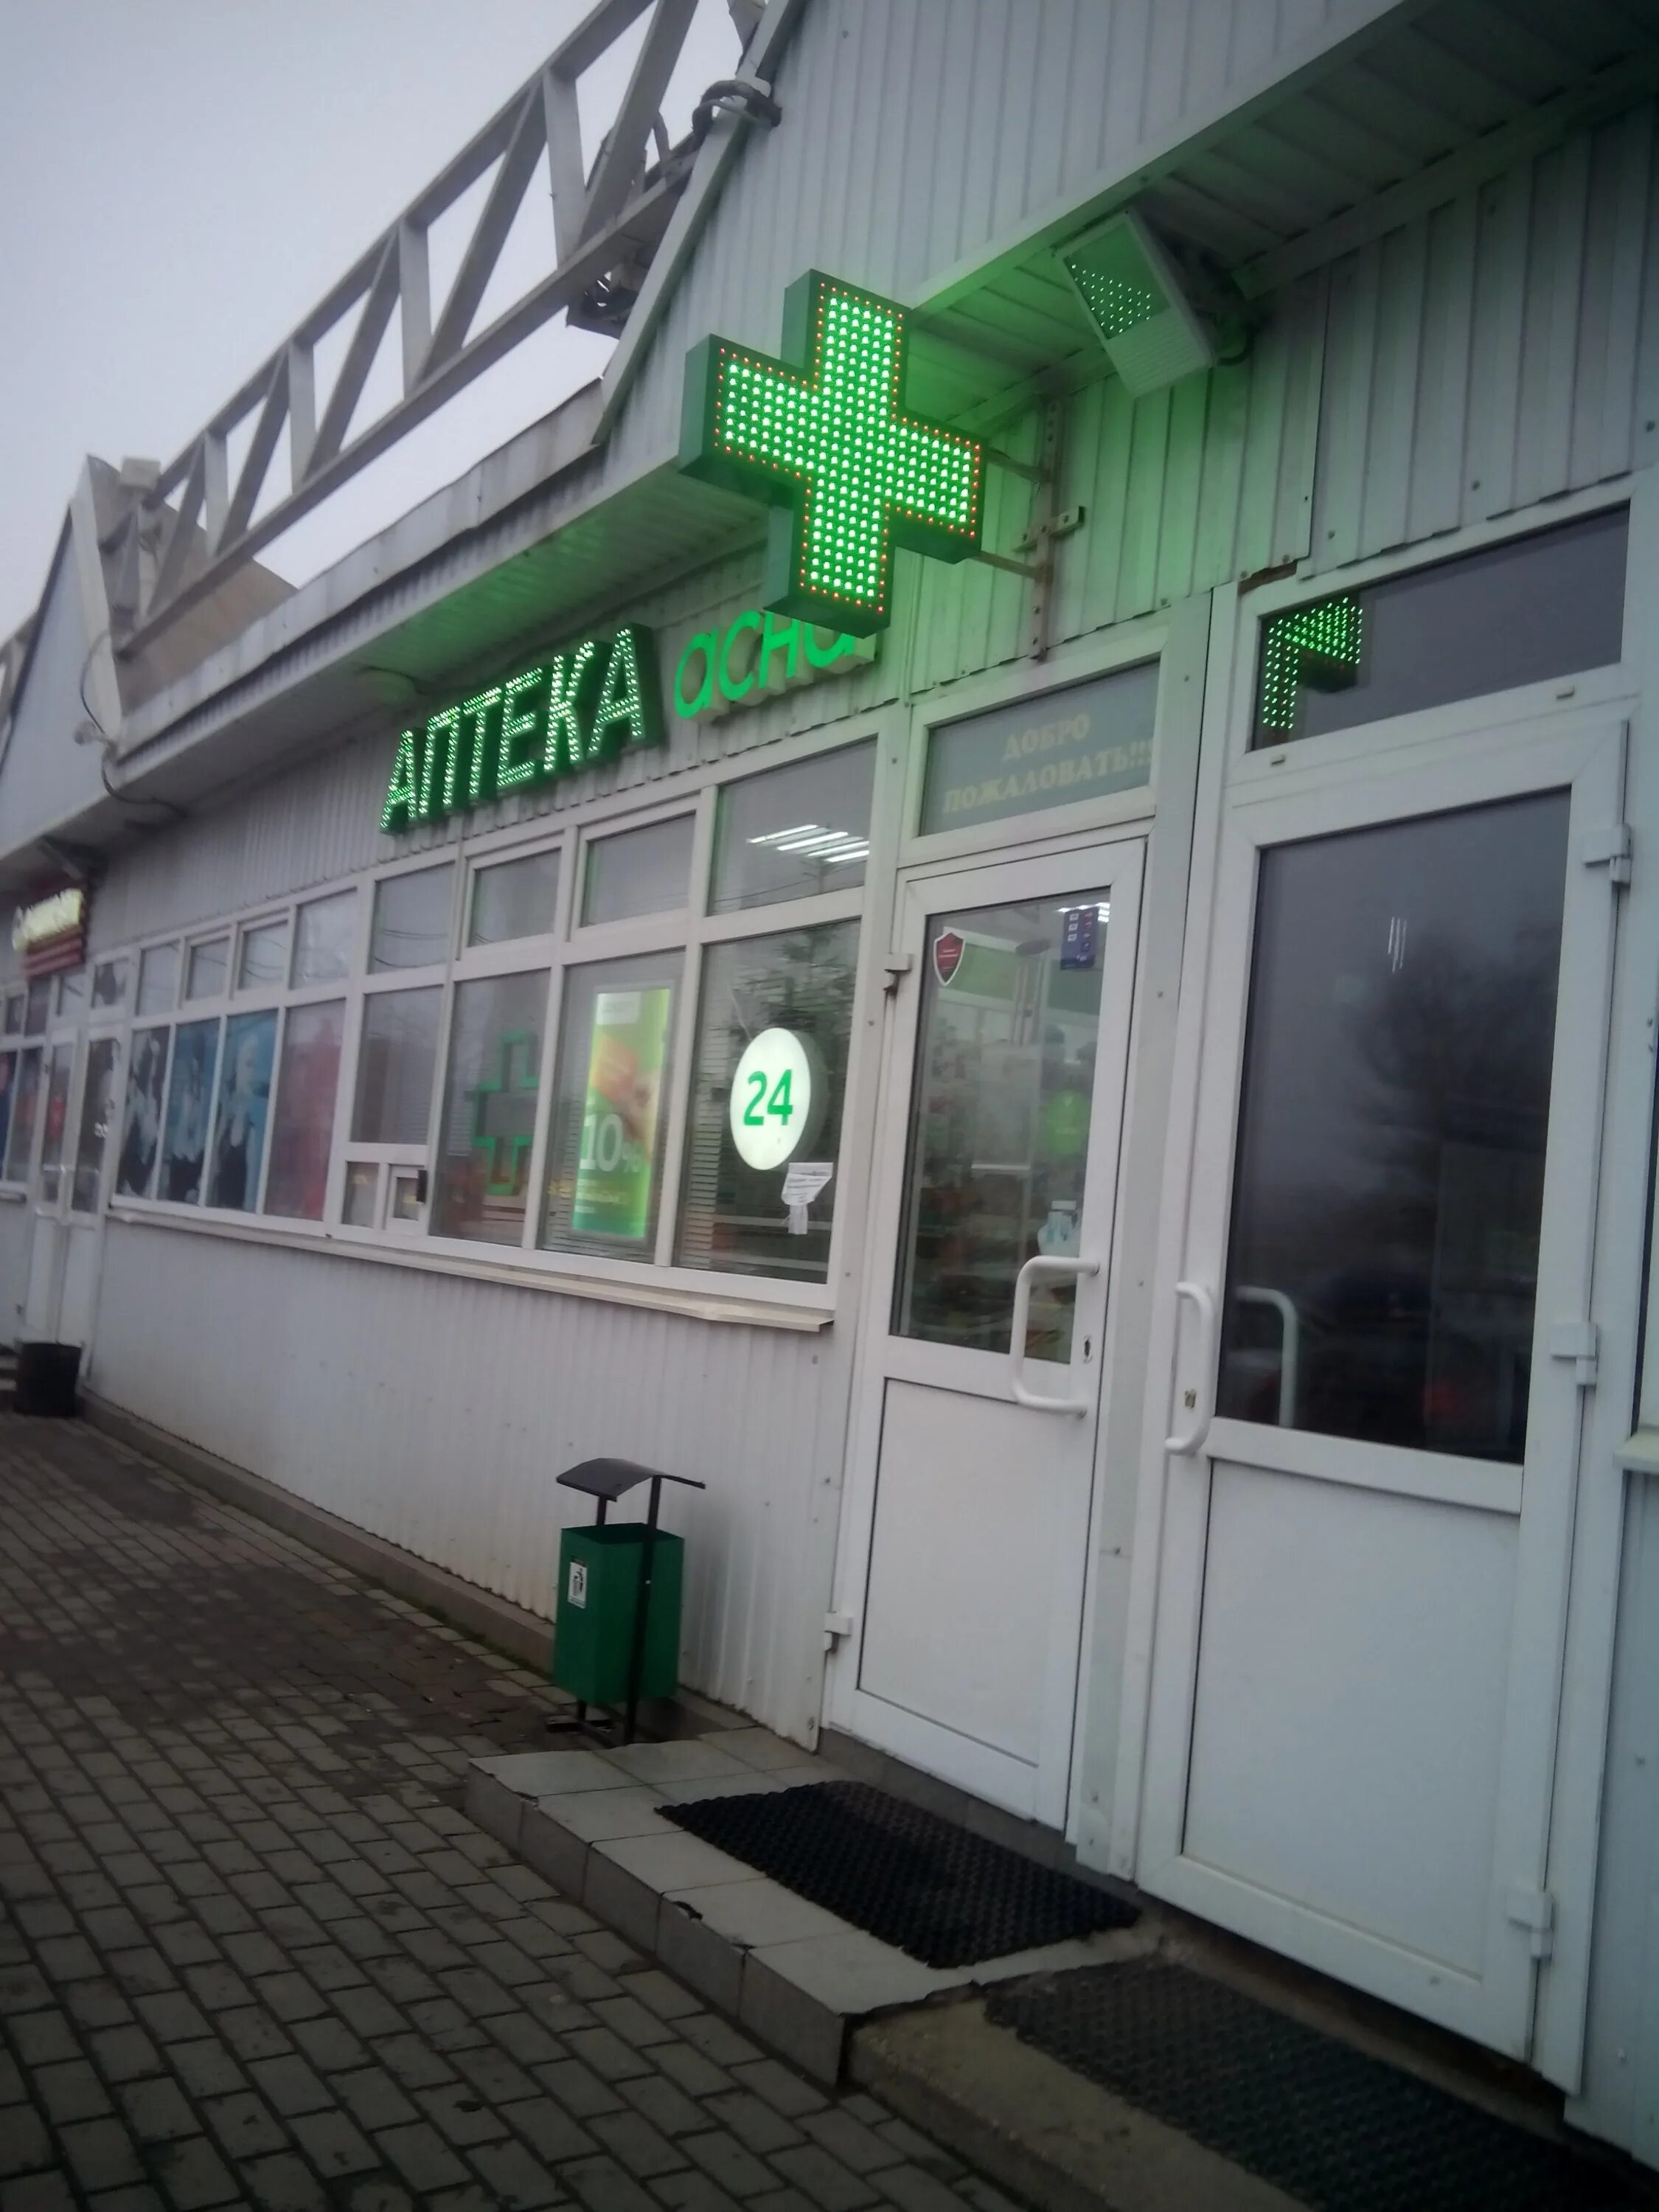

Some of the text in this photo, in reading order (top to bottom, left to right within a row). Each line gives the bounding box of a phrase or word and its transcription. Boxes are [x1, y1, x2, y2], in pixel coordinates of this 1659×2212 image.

[379, 626, 652, 833] АПТЕКА
[1003, 712, 1090, 762] ДОБРО
[743, 1069, 793, 1126] 24
